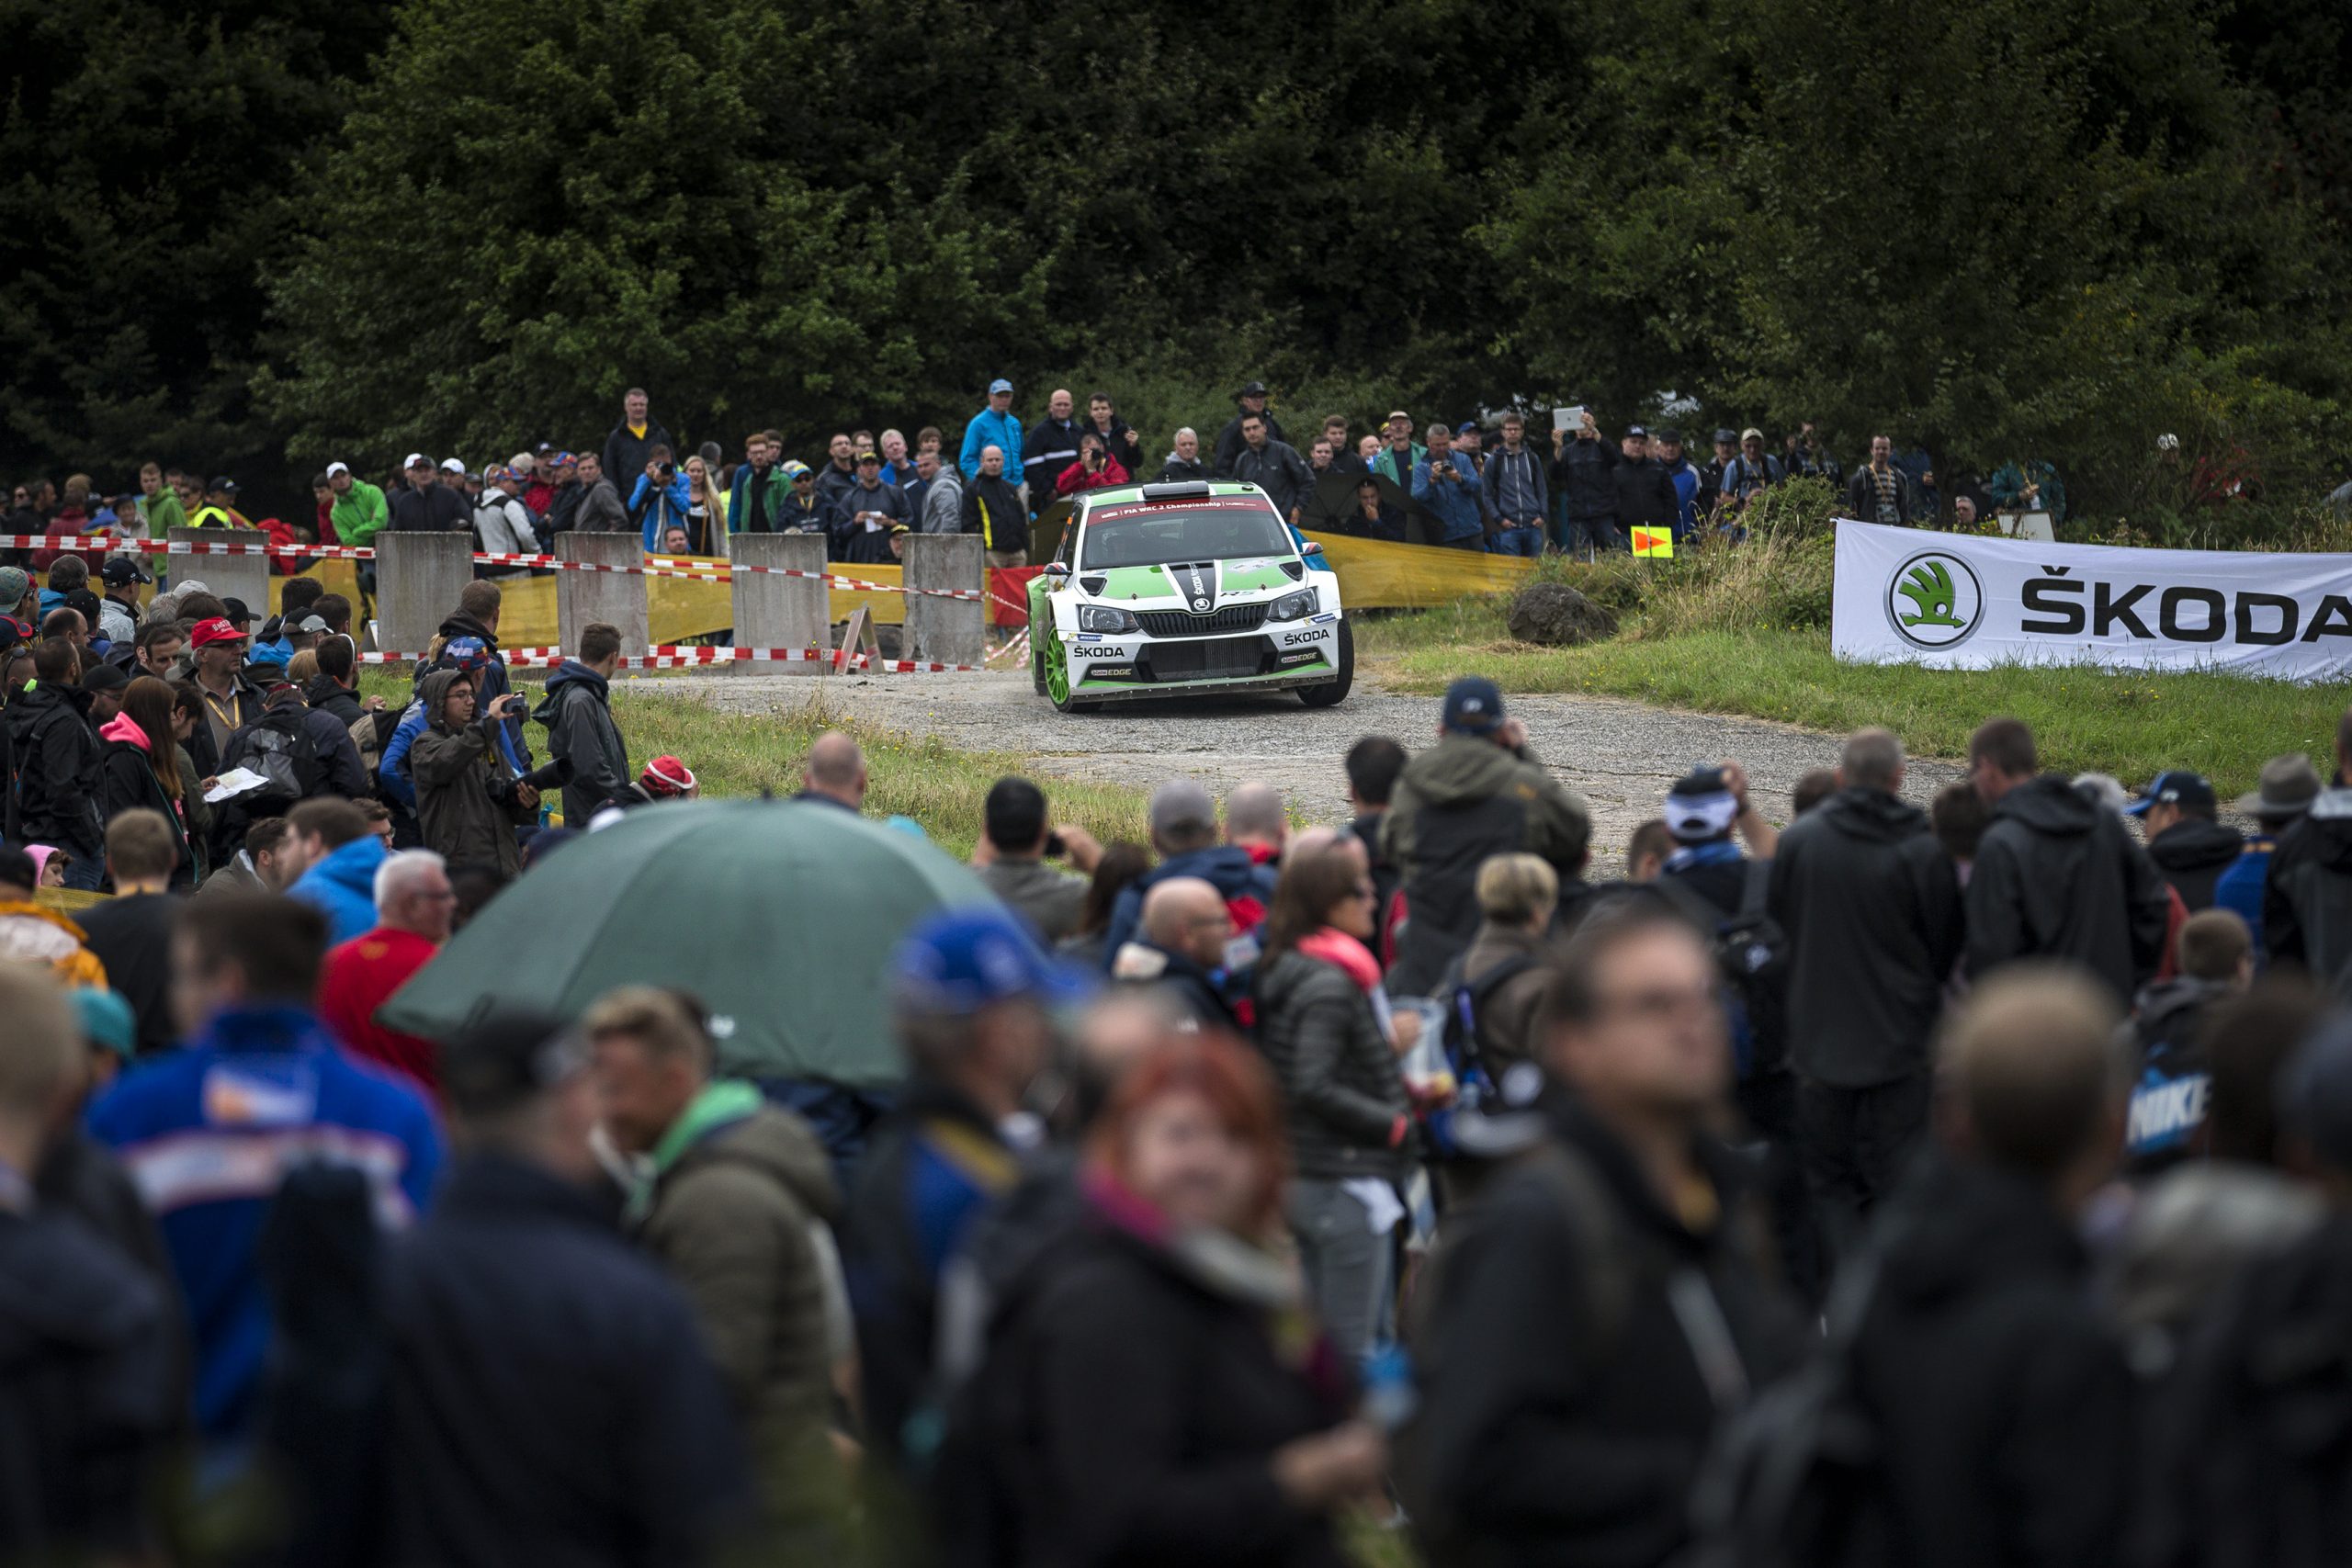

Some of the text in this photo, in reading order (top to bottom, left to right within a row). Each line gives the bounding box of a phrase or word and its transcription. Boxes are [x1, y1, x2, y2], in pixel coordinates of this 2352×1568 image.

[1166, 502, 1222, 510] Championship
[2021, 565, 2352, 645] ŠKODA
[1283, 628, 1330, 646] ŠKODA
[1073, 645, 1125, 658] ŠKODA
[1297, 651, 1317, 661] EDGE
[1107, 668, 1132, 676] EDGE
[2127, 1076, 2213, 1145] NIKE
